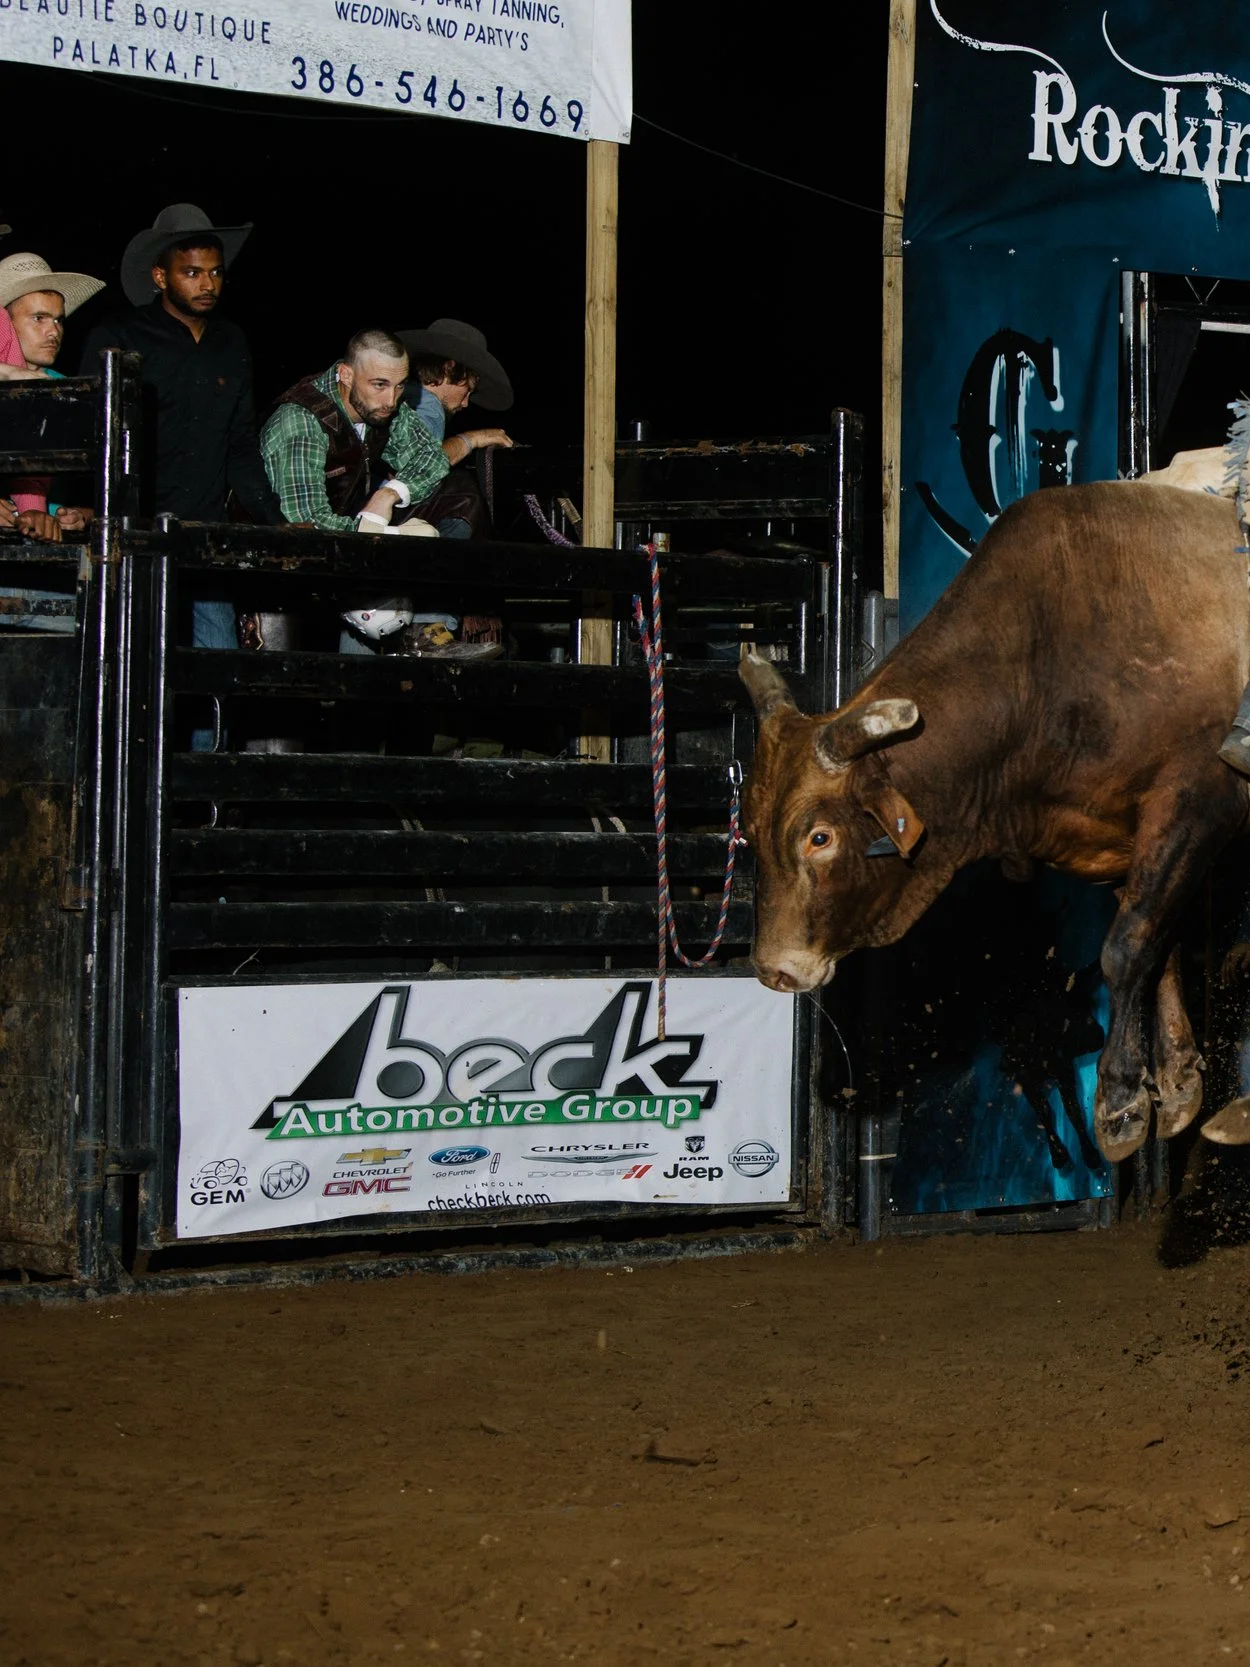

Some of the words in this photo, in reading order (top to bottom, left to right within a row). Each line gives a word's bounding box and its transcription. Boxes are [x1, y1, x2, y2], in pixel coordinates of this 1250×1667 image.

[135, 4, 271, 44] BOUTIQUE
[335, 1, 422, 32] WEDDINGS
[427, 17, 457, 39] AND
[464, 23, 529, 51] PARTY'S
[291, 56, 584, 132] 386-546-1669
[300, 981, 718, 1110] beck
[279, 1098, 556, 1136] Automotive
[561, 1096, 693, 1123] Group
[440, 1148, 479, 1163] Ford
[531, 1142, 650, 1152] CHRYSLER
[733, 1154, 775, 1163] NISSAN
[333, 1166, 409, 1178] CHEVROLET
[528, 1168, 636, 1178] DODGE
[663, 1163, 724, 1182] Jeep
[322, 1175, 412, 1197] GMC
[190, 1190, 246, 1206] GEM
[428, 1191, 551, 1210] checkbeckcom
